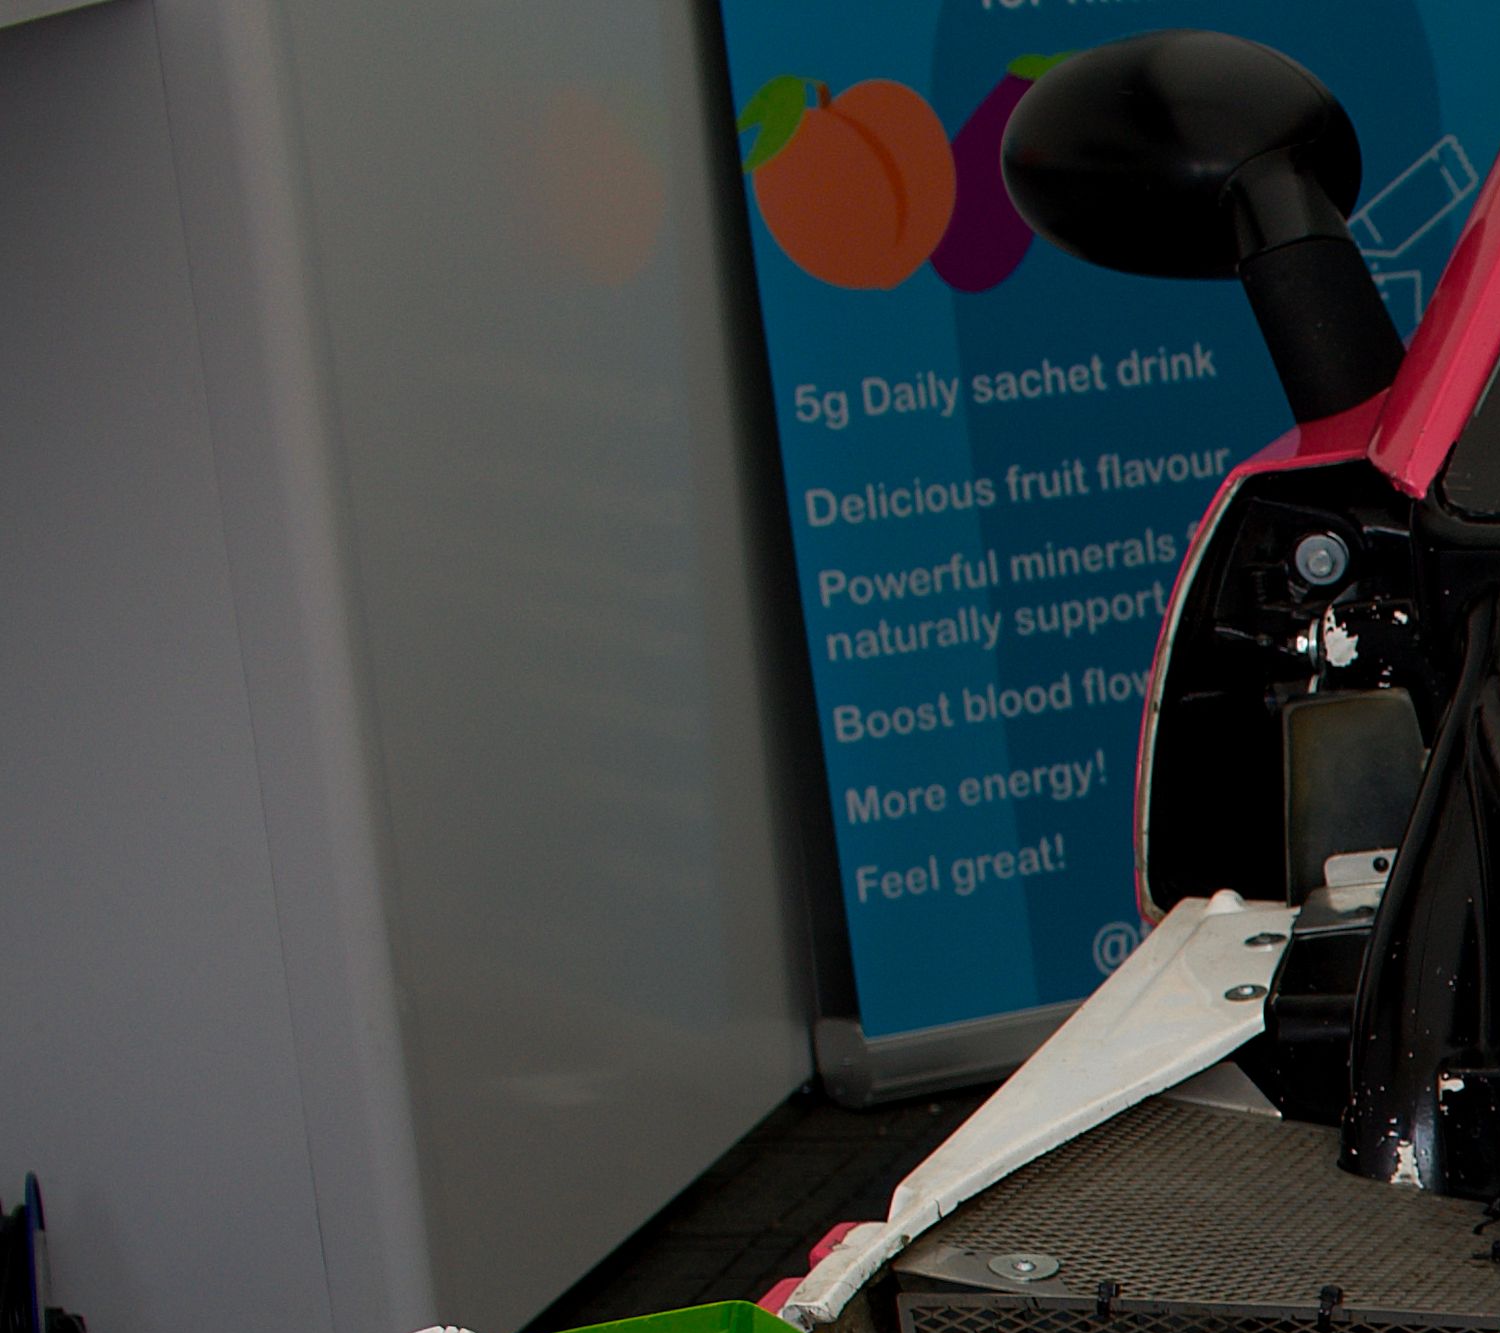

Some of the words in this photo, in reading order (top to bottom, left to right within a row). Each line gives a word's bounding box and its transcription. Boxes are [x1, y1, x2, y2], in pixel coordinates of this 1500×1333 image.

[793, 383, 850, 431] 5g
[861, 370, 960, 418] Daily
[971, 353, 1107, 405] sachet
[1115, 341, 1218, 388] drink
[804, 475, 998, 527] Delicious
[1006, 457, 1088, 504] fruit
[817, 549, 999, 608] Powerful
[1009, 526, 1177, 584] minerals
[825, 606, 1003, 662] naturally
[832, 690, 955, 744] Boost
[962, 672, 1073, 724] blood
[844, 782, 947, 826] More
[957, 748, 1108, 803] energy!
[855, 854, 940, 904] Feel
[949, 832, 1067, 897] great!
